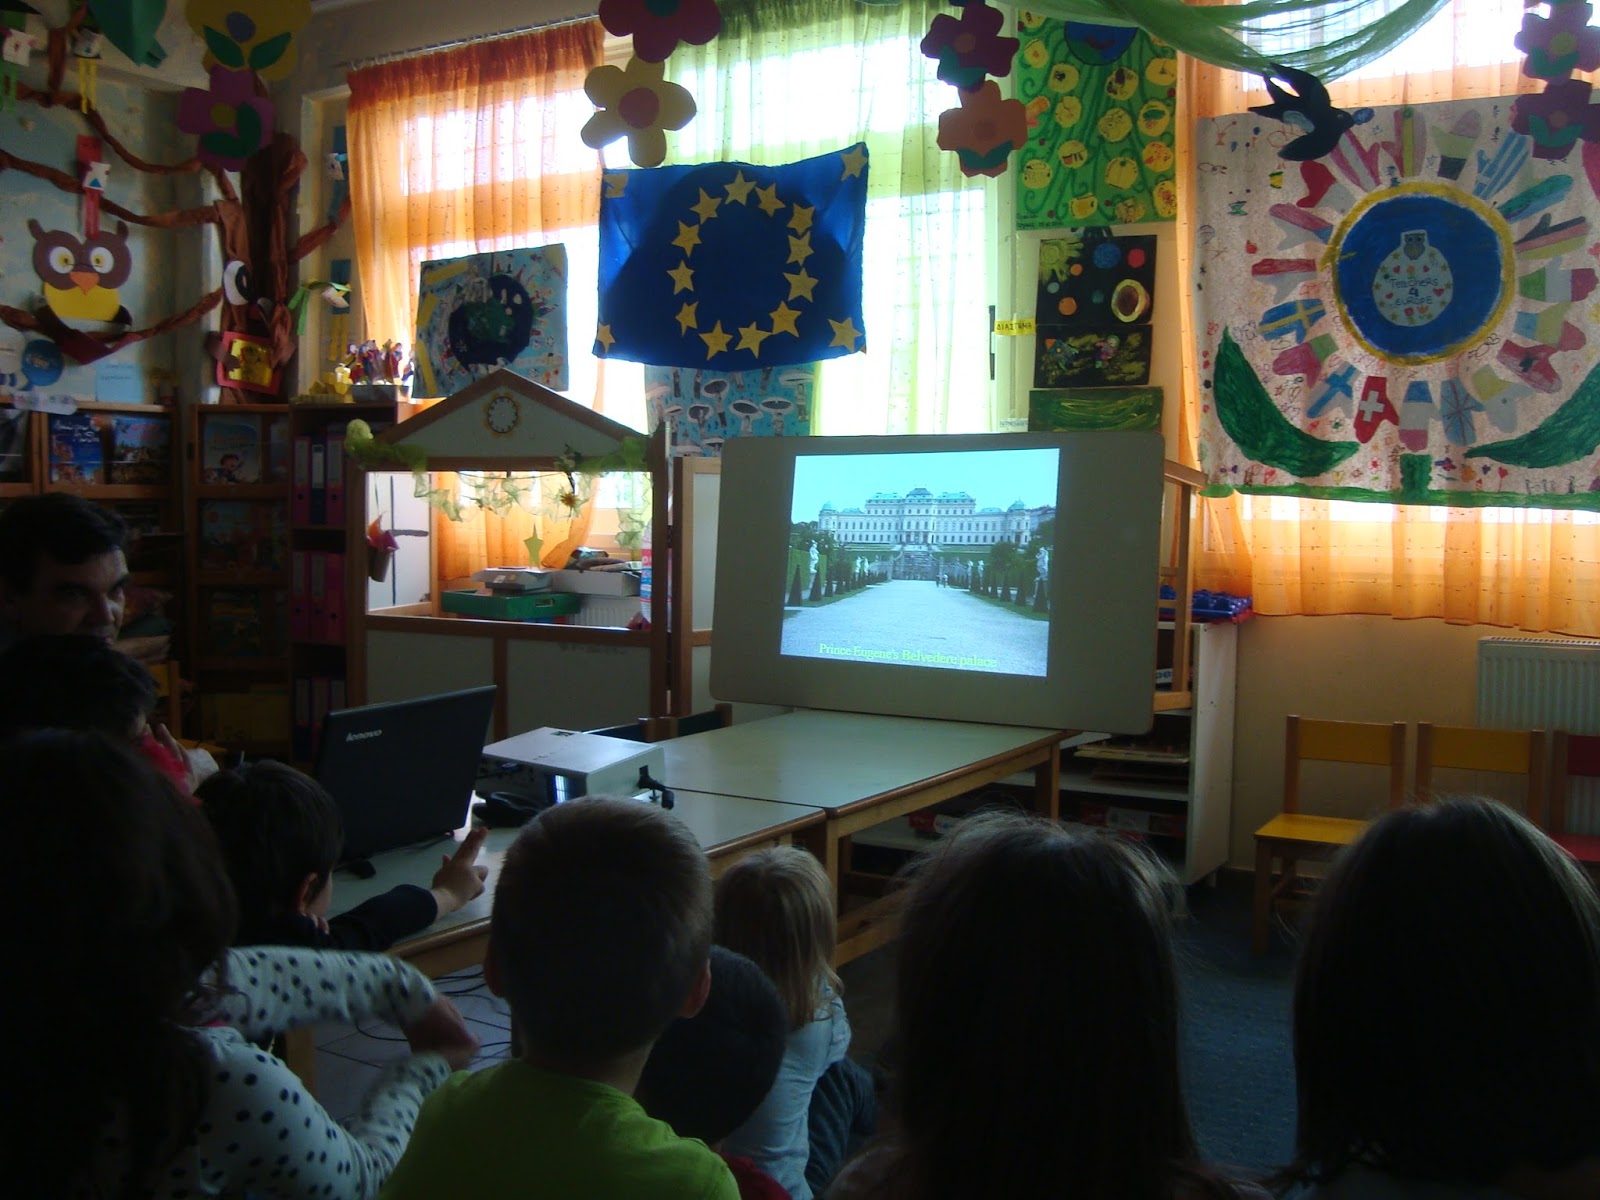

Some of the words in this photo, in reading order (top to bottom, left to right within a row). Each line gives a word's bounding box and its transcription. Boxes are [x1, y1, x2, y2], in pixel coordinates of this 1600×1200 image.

[1408, 287, 1420, 297] 4
[818, 643, 852, 656] Prince
[853, 645, 900, 661] Eugene's
[902, 650, 958, 664] Belvedere
[959, 654, 997, 668] palace
